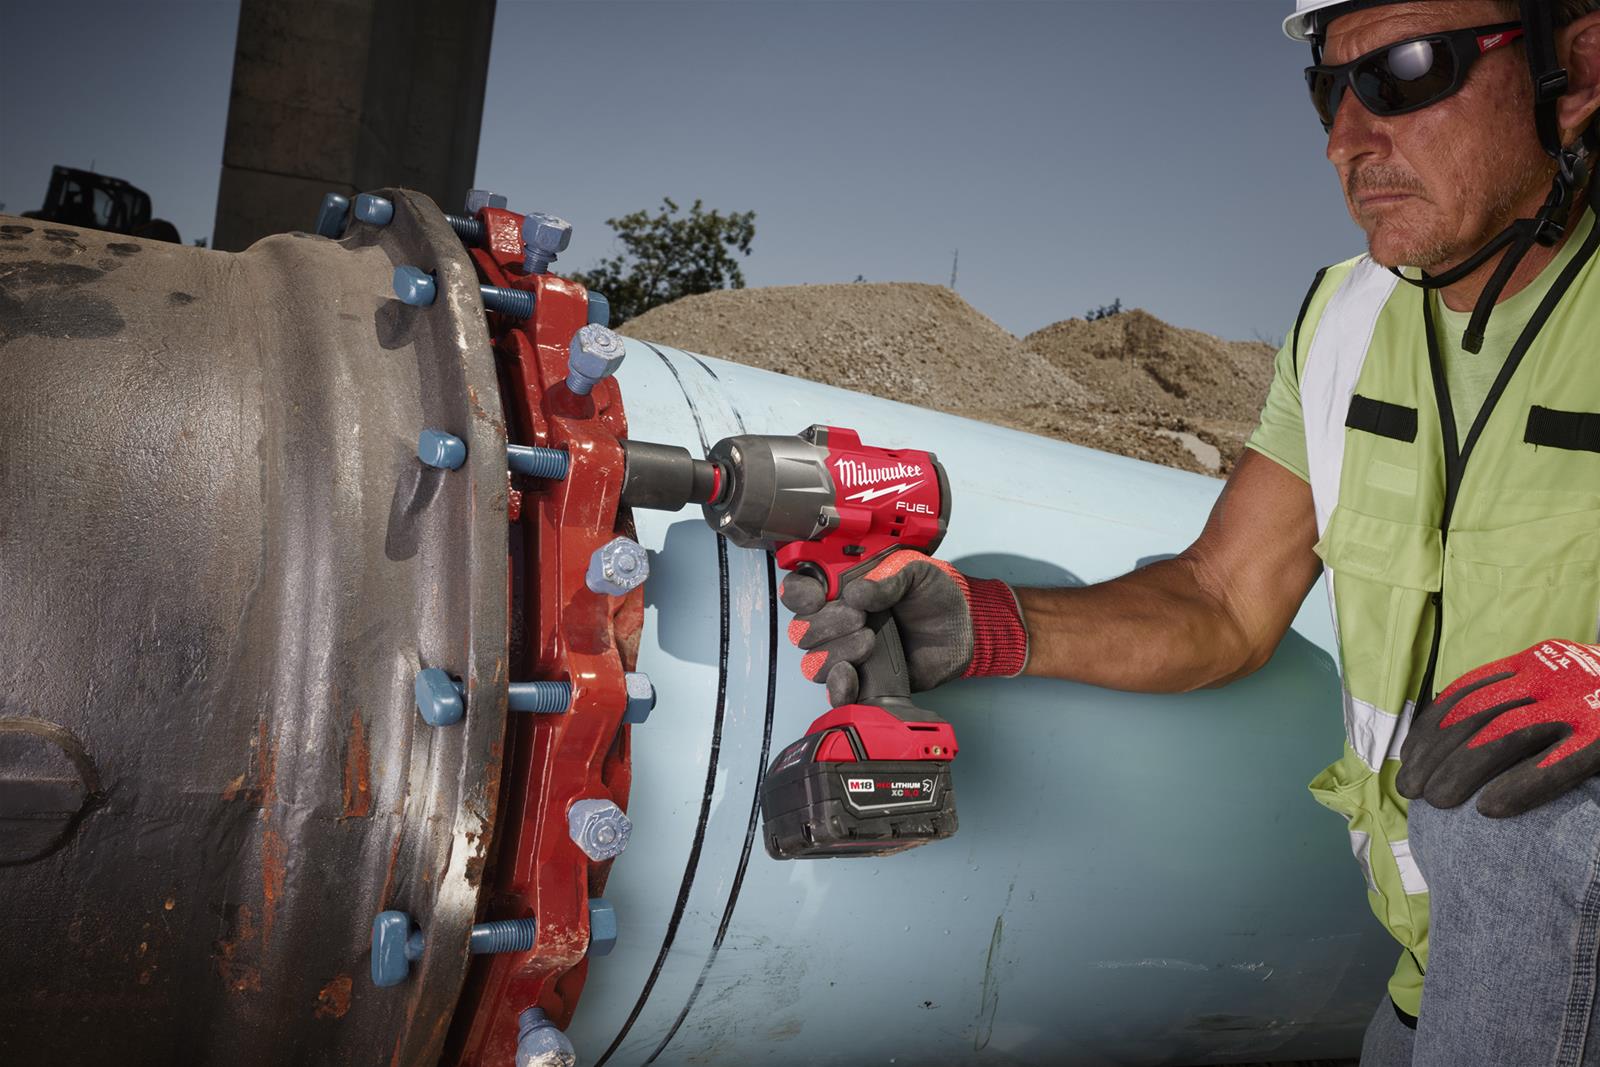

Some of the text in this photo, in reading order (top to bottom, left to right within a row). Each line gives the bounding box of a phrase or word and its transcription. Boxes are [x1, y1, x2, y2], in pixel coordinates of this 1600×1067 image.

[834, 458, 924, 488] Milwaukee
[896, 501, 934, 514] FUEL
[849, 781, 873, 790] M18
